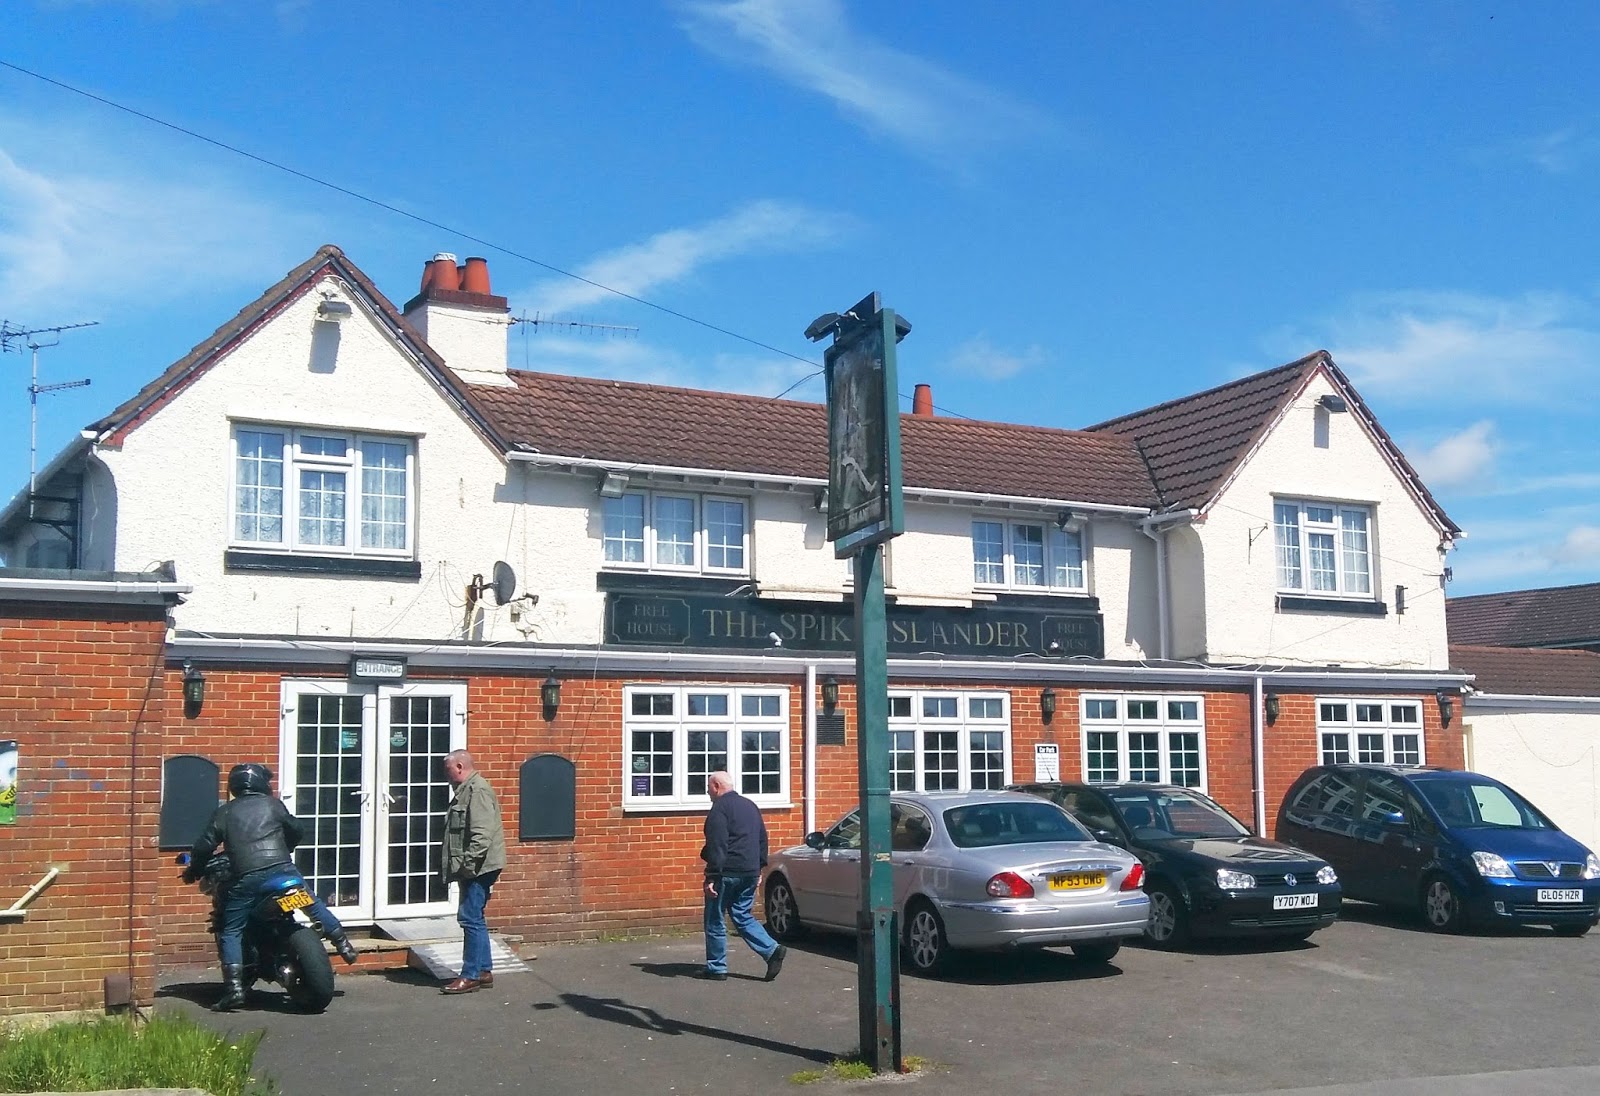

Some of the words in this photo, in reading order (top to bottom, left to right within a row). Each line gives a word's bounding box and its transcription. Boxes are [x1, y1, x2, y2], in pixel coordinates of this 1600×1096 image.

[634, 604, 670, 617] FREE
[627, 621, 676, 636] HOUSE
[702, 609, 768, 639] THE
[780, 612, 853, 642] SPIK
[883, 619, 1031, 648] SLANDER
[1057, 622, 1084, 634] FREE
[357, 662, 402, 674] ENTRANCE
[1541, 890, 1564, 900] GL05
[1564, 890, 1580, 900] HZR
[1278, 896, 1298, 907] Y707
